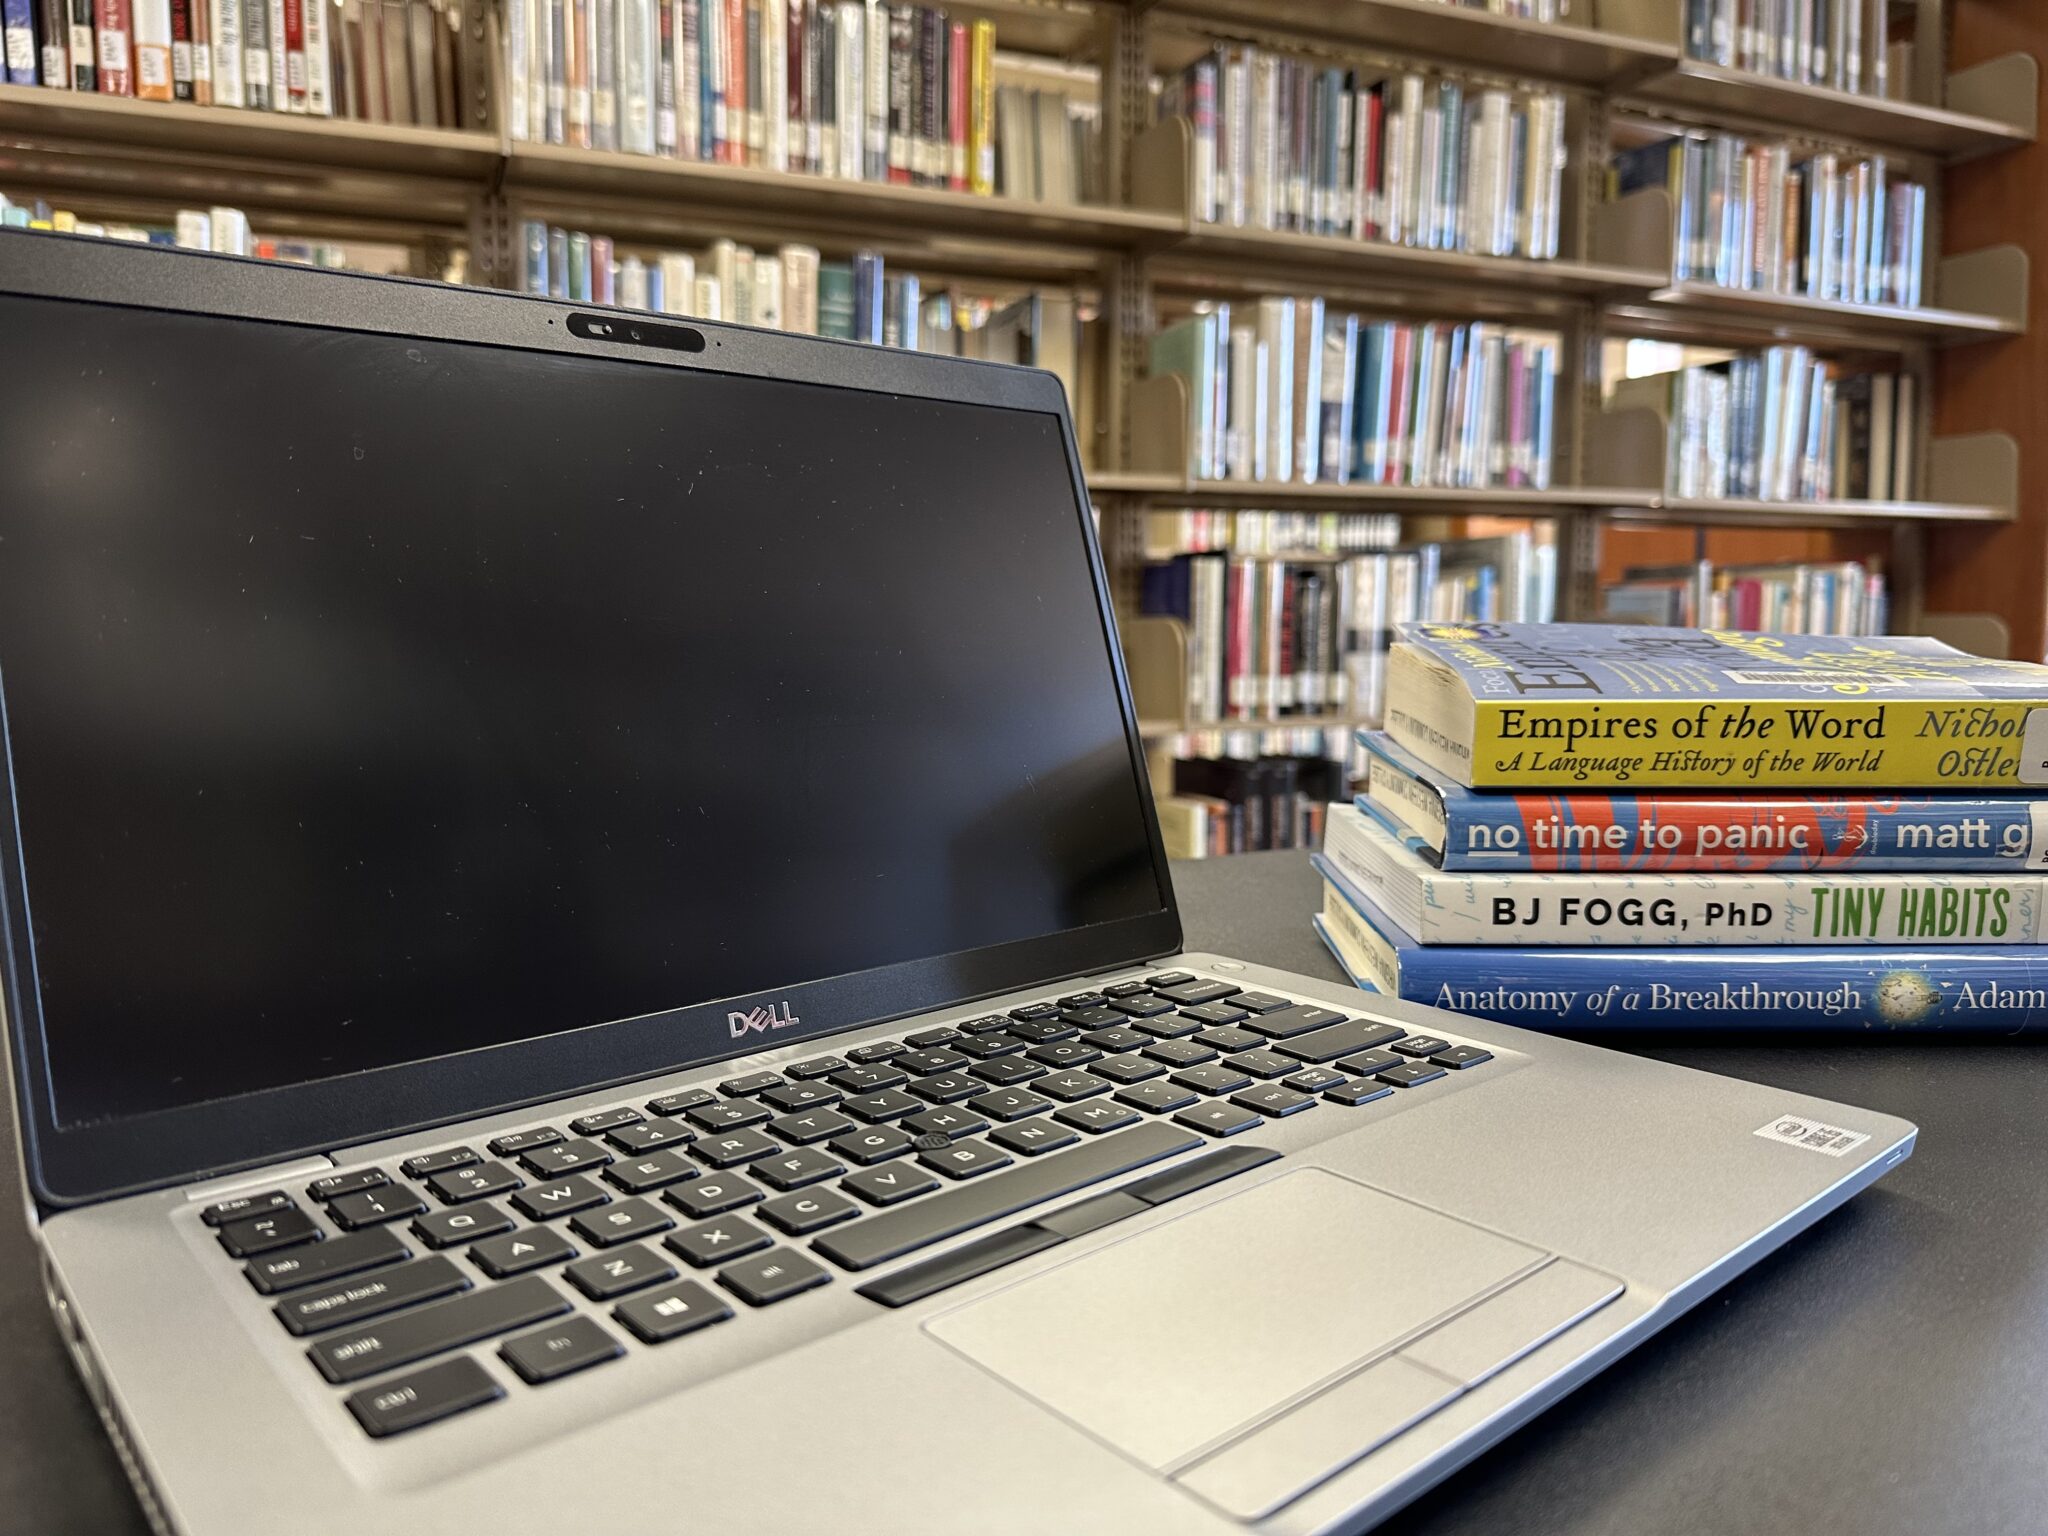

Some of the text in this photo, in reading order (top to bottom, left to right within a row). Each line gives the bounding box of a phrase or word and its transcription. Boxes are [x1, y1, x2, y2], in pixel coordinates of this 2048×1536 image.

[1497, 707, 1658, 752] Empires
[1672, 705, 1713, 738] of
[1720, 705, 1774, 738] the
[1785, 705, 1886, 739] Word
[1495, 750, 1885, 780] A Language History of the World
[1468, 815, 1810, 857] no time to panic
[1870, 819, 1879, 855] doubleday
[1896, 818, 1991, 849] matt
[2001, 823, 2029, 858] g
[1491, 897, 1773, 931] BJ FOGG, PhD
[1811, 887, 2011, 938] TINY HABITS
[1433, 981, 1861, 1017] Anatomy of a Breakthrough
[1952, 981, 2047, 1011] Adam
[728, 1001, 800, 1038] DELL
[1055, 1047, 1073, 1055] O
[1117, 1063, 1137, 1071] L
[936, 1080, 956, 1089] U
[1060, 1078, 1081, 1087] K
[870, 1098, 887, 1106] Y
[1006, 1096, 1020, 1105] J
[1084, 1108, 1110, 1118] M
[797, 1117, 816, 1127] T
[933, 1114, 957, 1125] H
[650, 1131, 664, 1139] 4
[1020, 1127, 1046, 1139] N
[721, 1140, 745, 1150] R
[864, 1135, 886, 1146] G
[952, 1150, 976, 1161] B
[637, 1162, 662, 1174] E
[784, 1159, 802, 1171] F
[874, 1173, 897, 1185] V
[540, 1185, 572, 1201] W
[698, 1185, 723, 1198] D
[795, 1200, 820, 1213] C
[448, 1214, 476, 1228] Q
[607, 1212, 632, 1226] S
[702, 1229, 732, 1245] X
[511, 1241, 536, 1257] A
